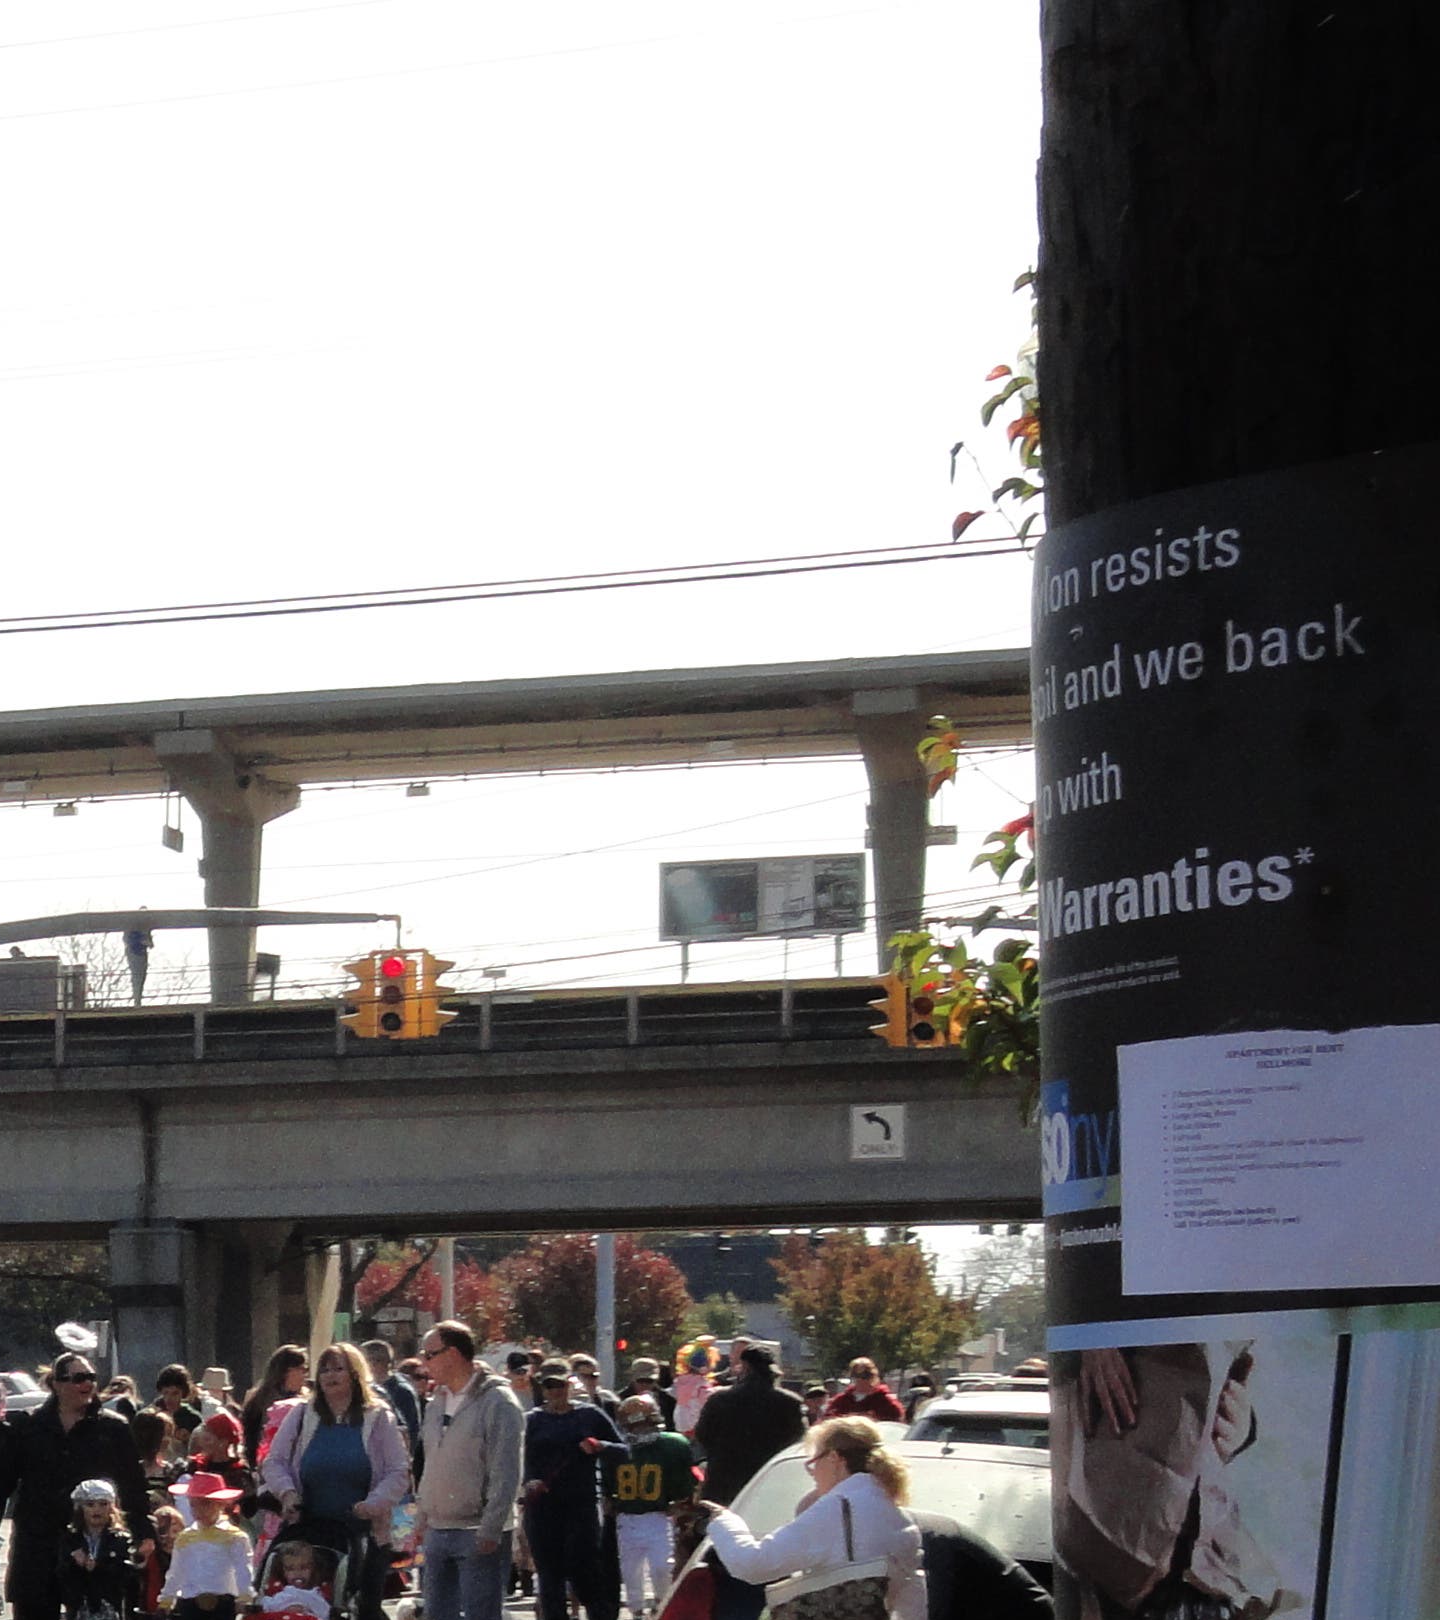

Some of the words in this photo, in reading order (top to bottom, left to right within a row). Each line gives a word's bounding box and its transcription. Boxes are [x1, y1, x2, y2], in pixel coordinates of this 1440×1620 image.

[1091, 525, 1241, 598] resists
[1064, 643, 1122, 711] and
[1134, 640, 1205, 690] we
[1225, 602, 1366, 674] back
[1058, 755, 1123, 820] with
[616, 1463, 663, 1501] 80
